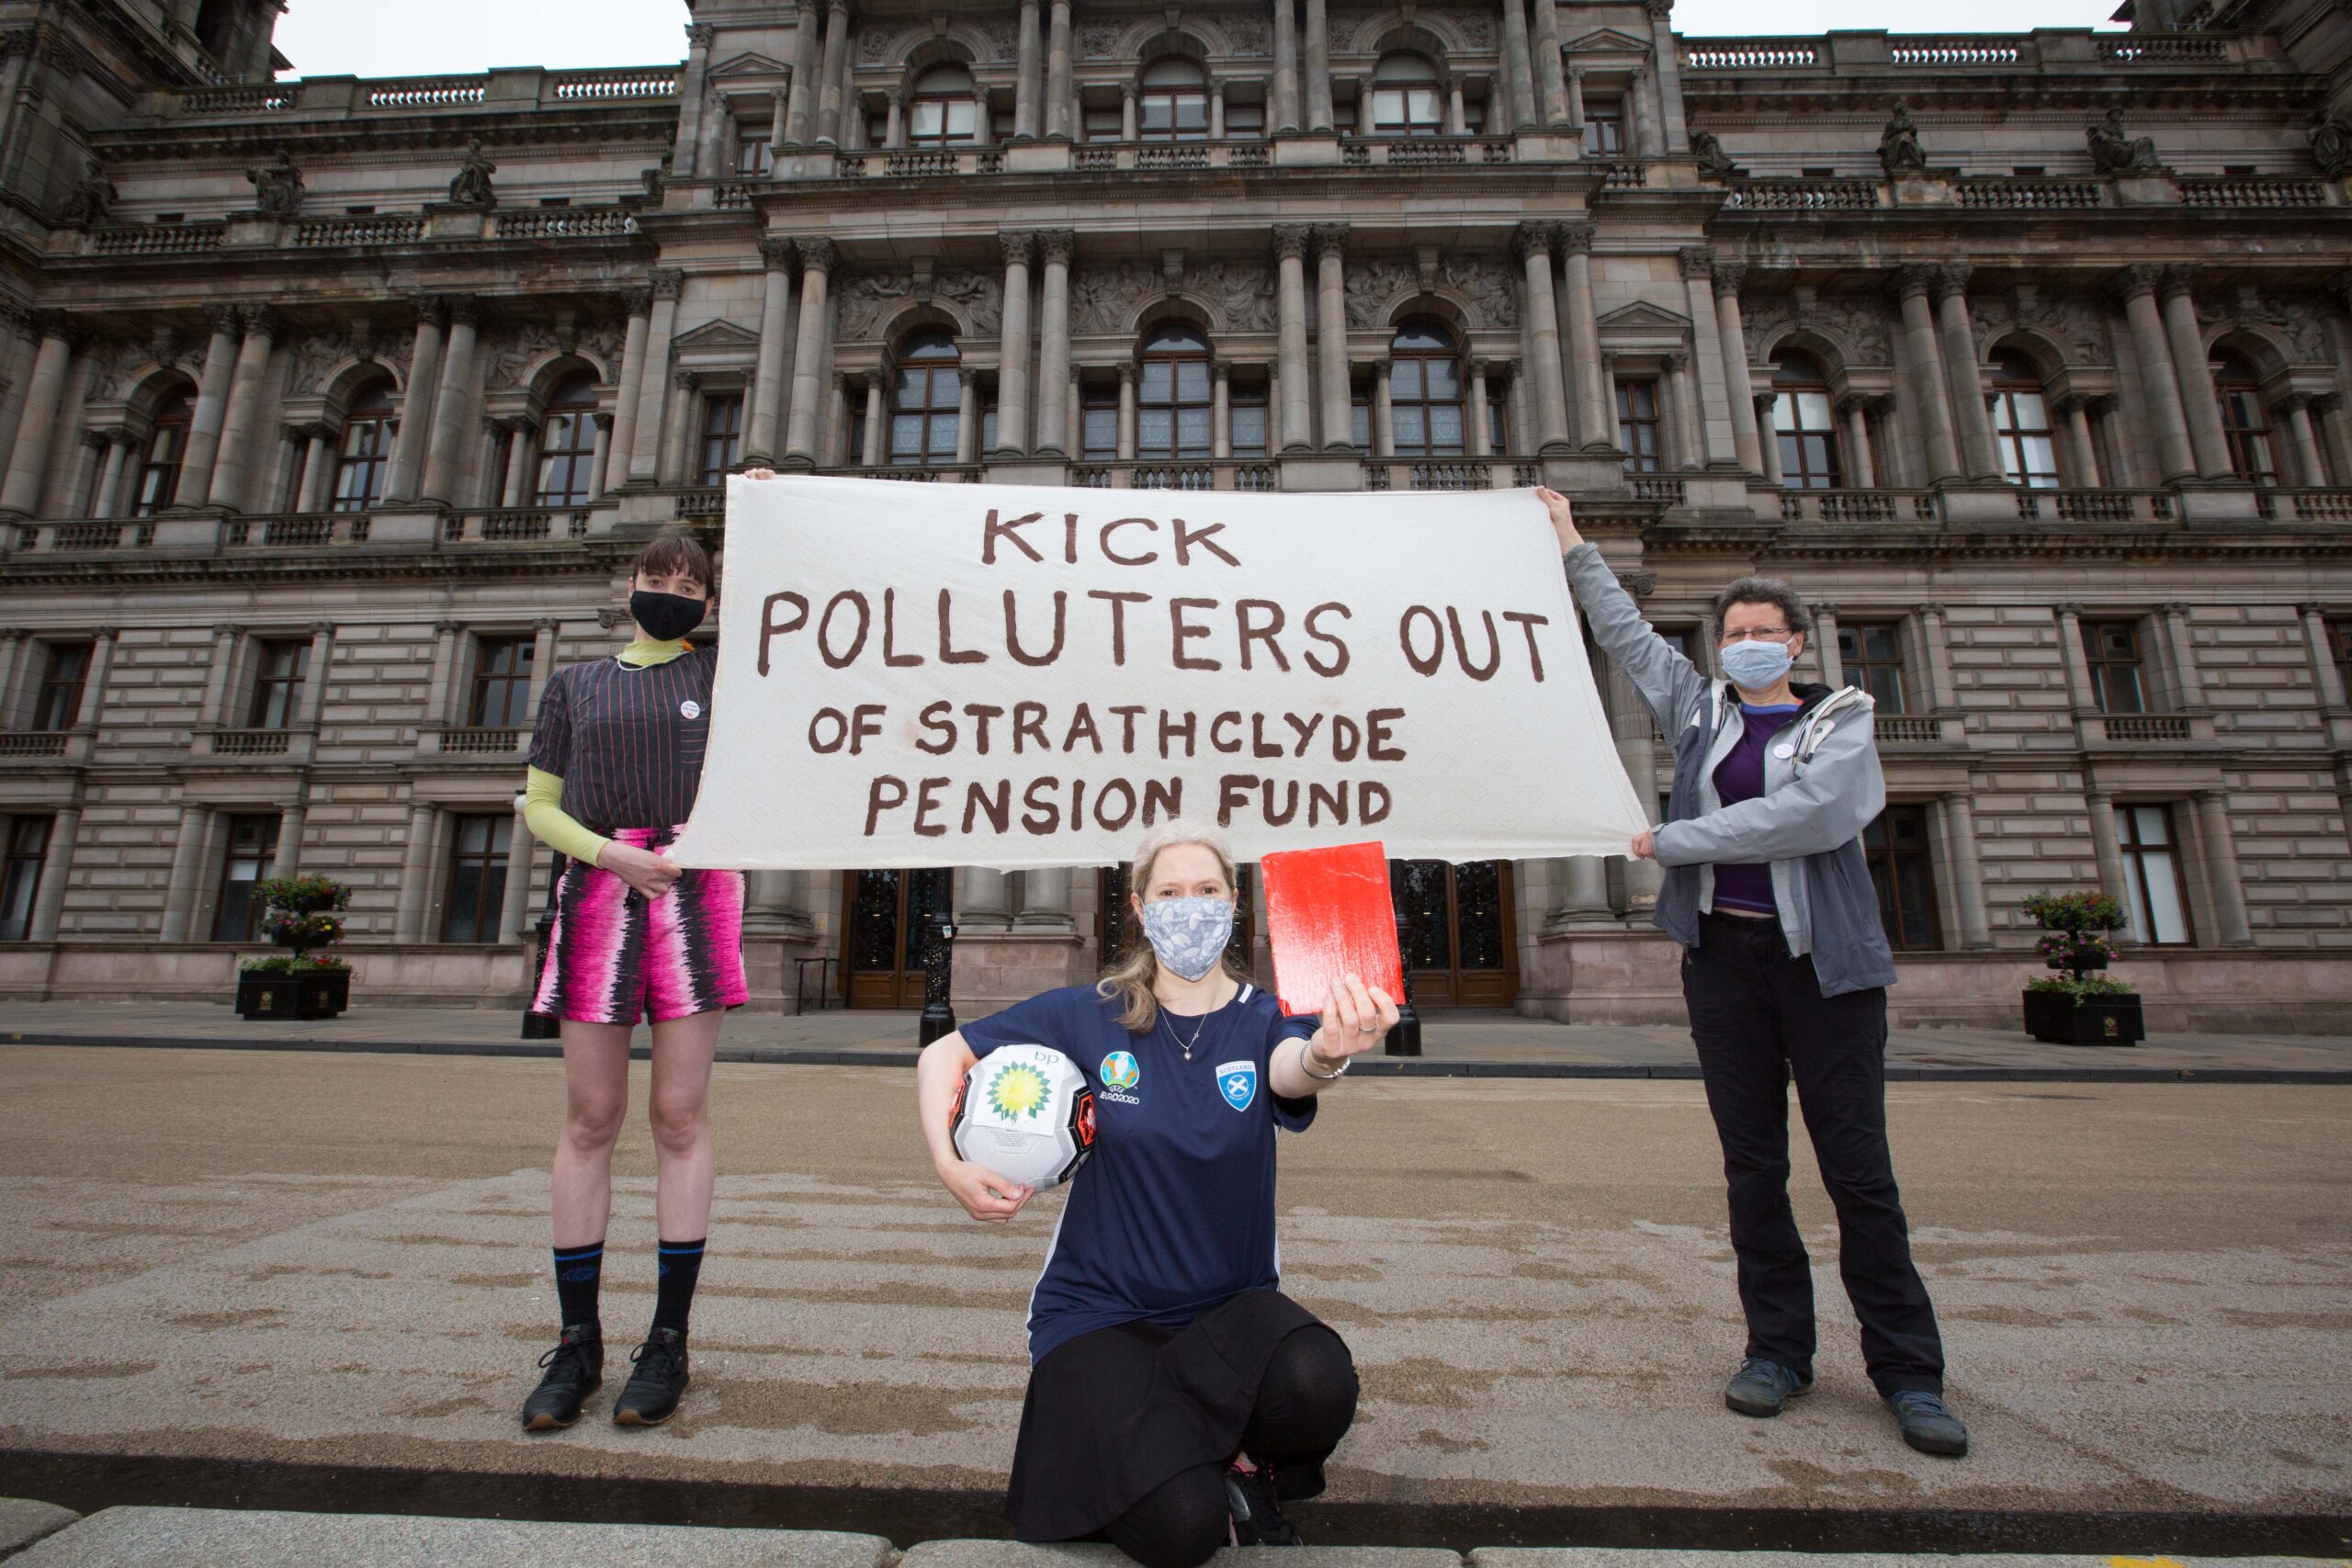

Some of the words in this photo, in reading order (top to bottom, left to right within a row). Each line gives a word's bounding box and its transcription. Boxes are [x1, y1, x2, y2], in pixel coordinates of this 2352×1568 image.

[982, 509, 1241, 568] KICK
[757, 587, 1352, 678] POLLUTERS
[1399, 604, 1549, 683] OUT
[808, 704, 888, 756] OF
[915, 700, 1408, 762] STRATHCLYDE
[863, 773, 1183, 838] PENSION
[1216, 773, 1392, 829] FUND
[1035, 1051, 1059, 1066] bp
[1219, 1065, 1252, 1074] SCOTLAND
[1108, 1085, 1125, 1094] UEFA
